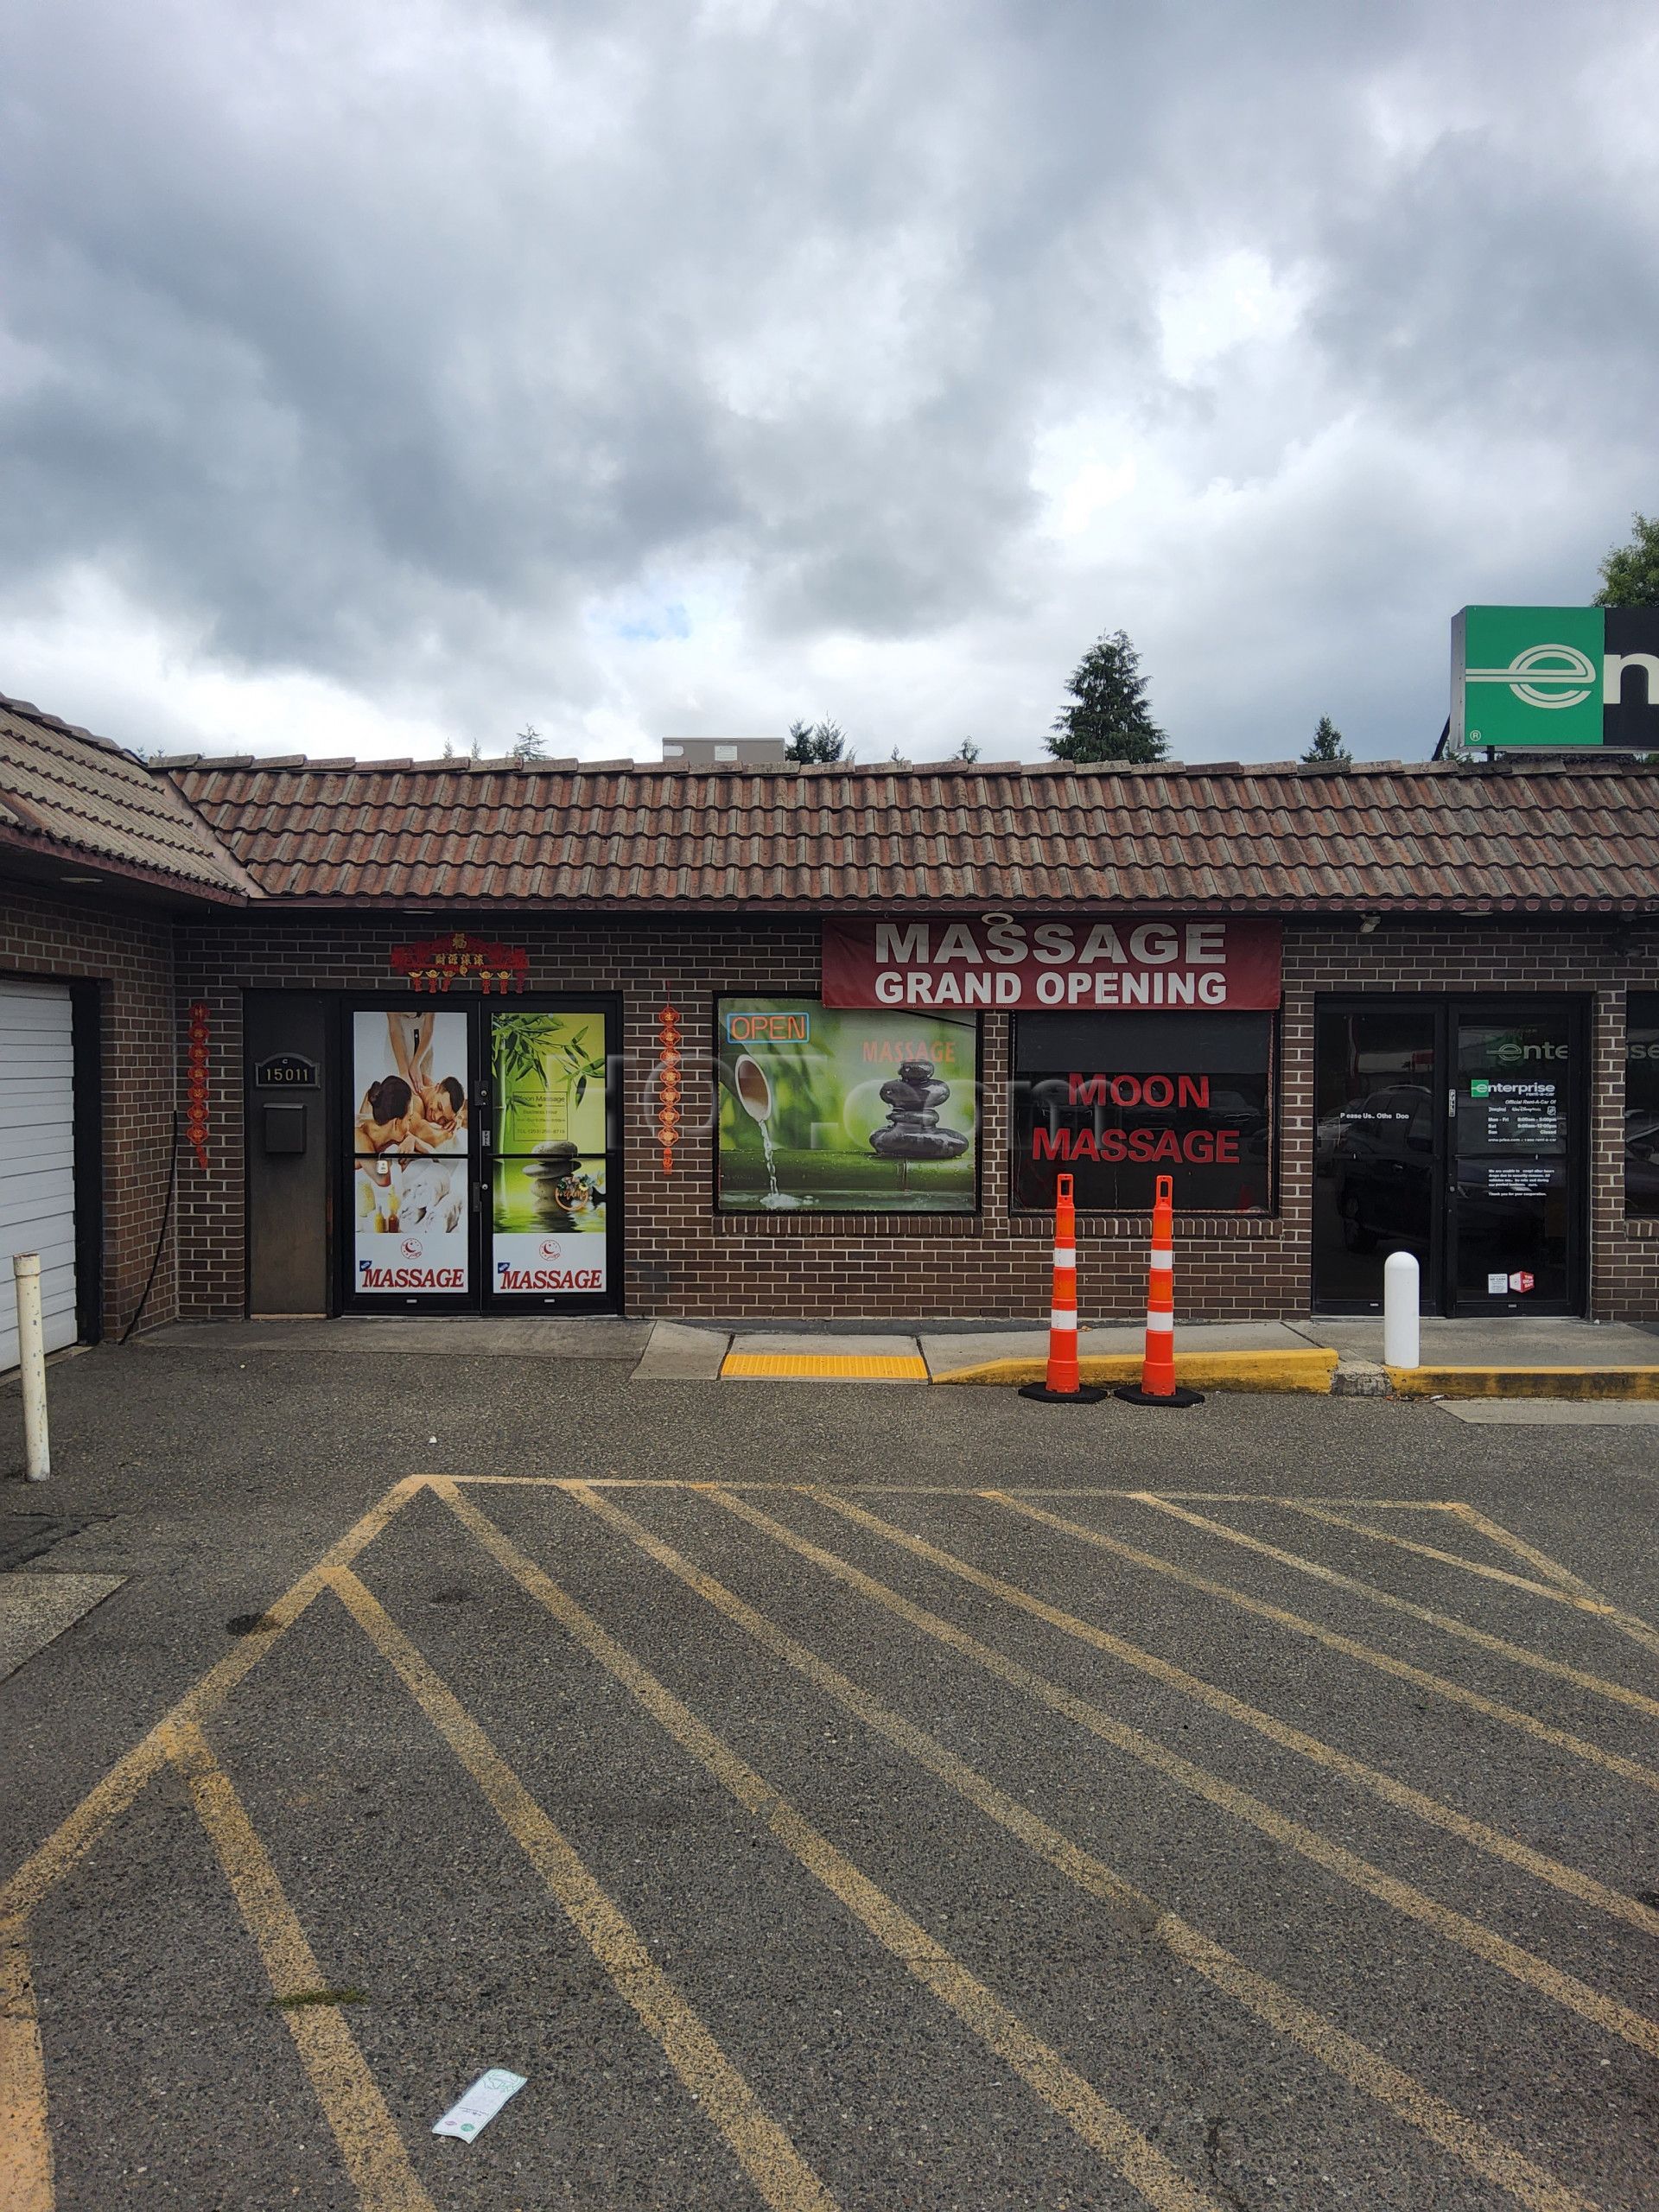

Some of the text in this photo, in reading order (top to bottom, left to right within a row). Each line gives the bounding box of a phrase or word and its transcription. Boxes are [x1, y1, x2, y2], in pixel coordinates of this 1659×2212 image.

[875, 923, 1227, 964] MASSAGE
[874, 971, 1228, 1005] GRAND OPENING
[730, 1015, 806, 1041] OPEN
[862, 1041, 956, 1064] MASSAGE
[266, 1068, 308, 1082] 15011
[1069, 1075, 1210, 1109] MOON
[1471, 1082, 1556, 1096] enterprise
[1033, 1128, 1241, 1165] MASSAGE
[361, 1268, 465, 1288] MASSAGE
[499, 1269, 603, 1289] MASSAGE
